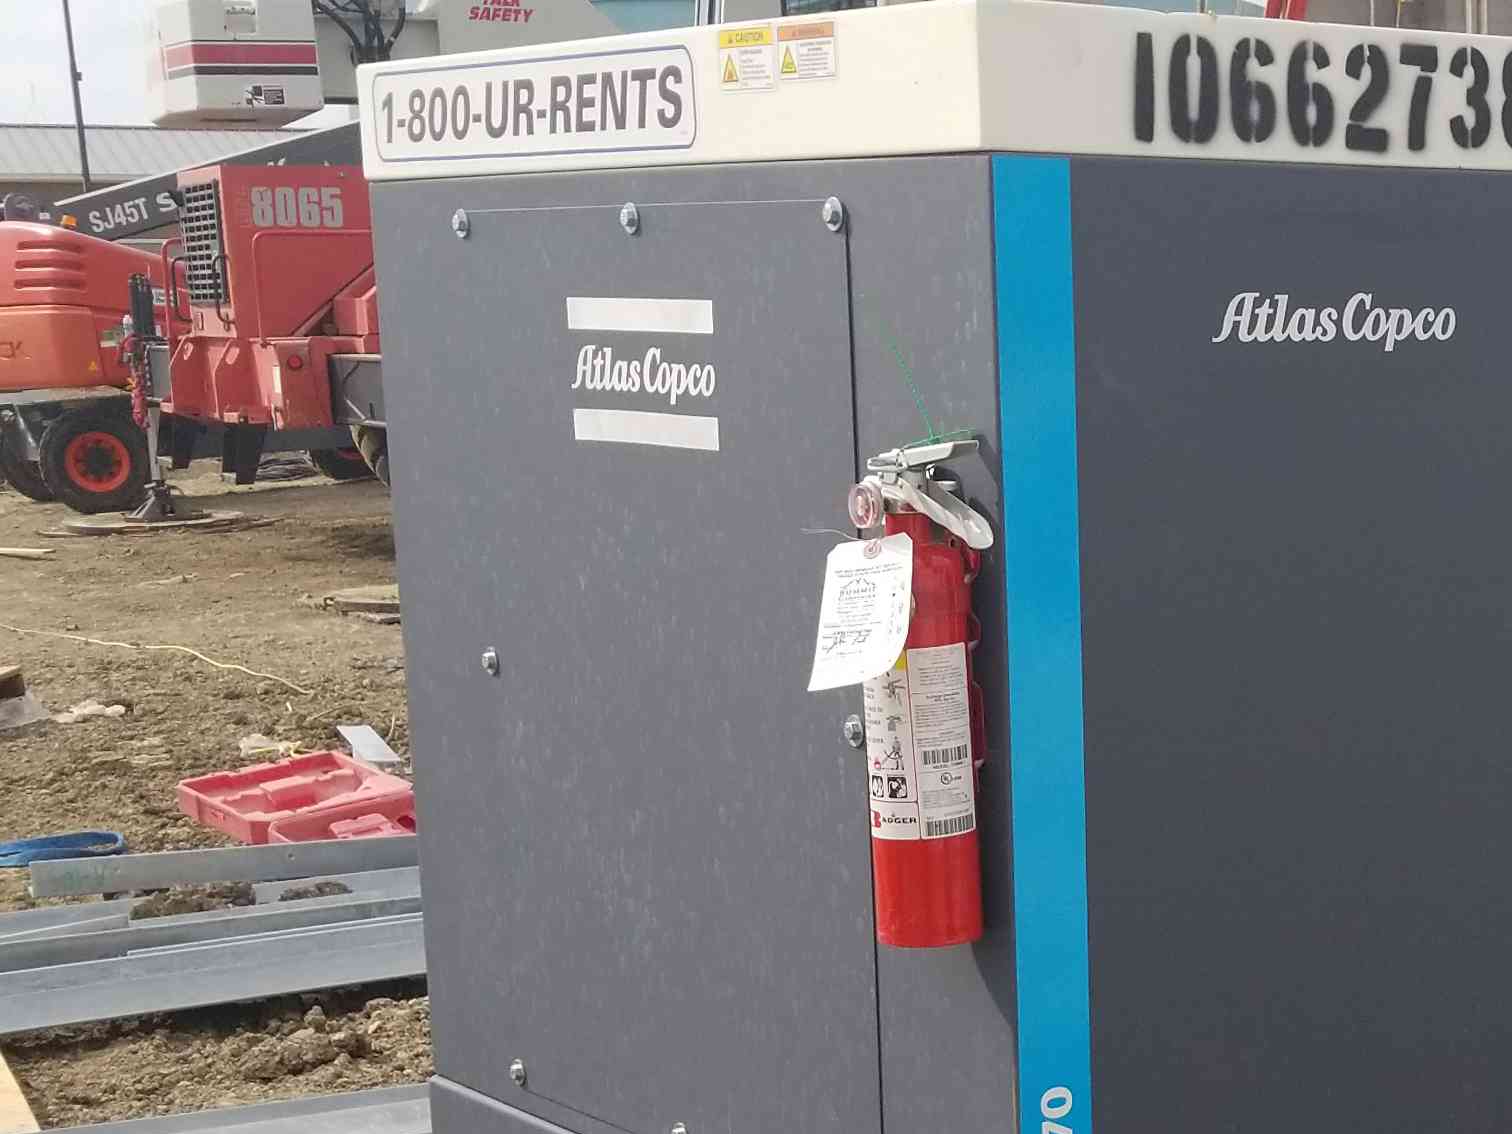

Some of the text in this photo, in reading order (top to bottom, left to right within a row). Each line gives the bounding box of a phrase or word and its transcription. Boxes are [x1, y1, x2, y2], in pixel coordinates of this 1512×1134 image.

[468, 6, 534, 23] SAFETY
[381, 64, 683, 144] 1-800-UR-RENTS
[88, 197, 149, 234] SJ45T
[251, 186, 344, 227] 8065
[1211, 291, 1457, 352] Atlas Copco
[570, 344, 716, 405] Atlas Copco
